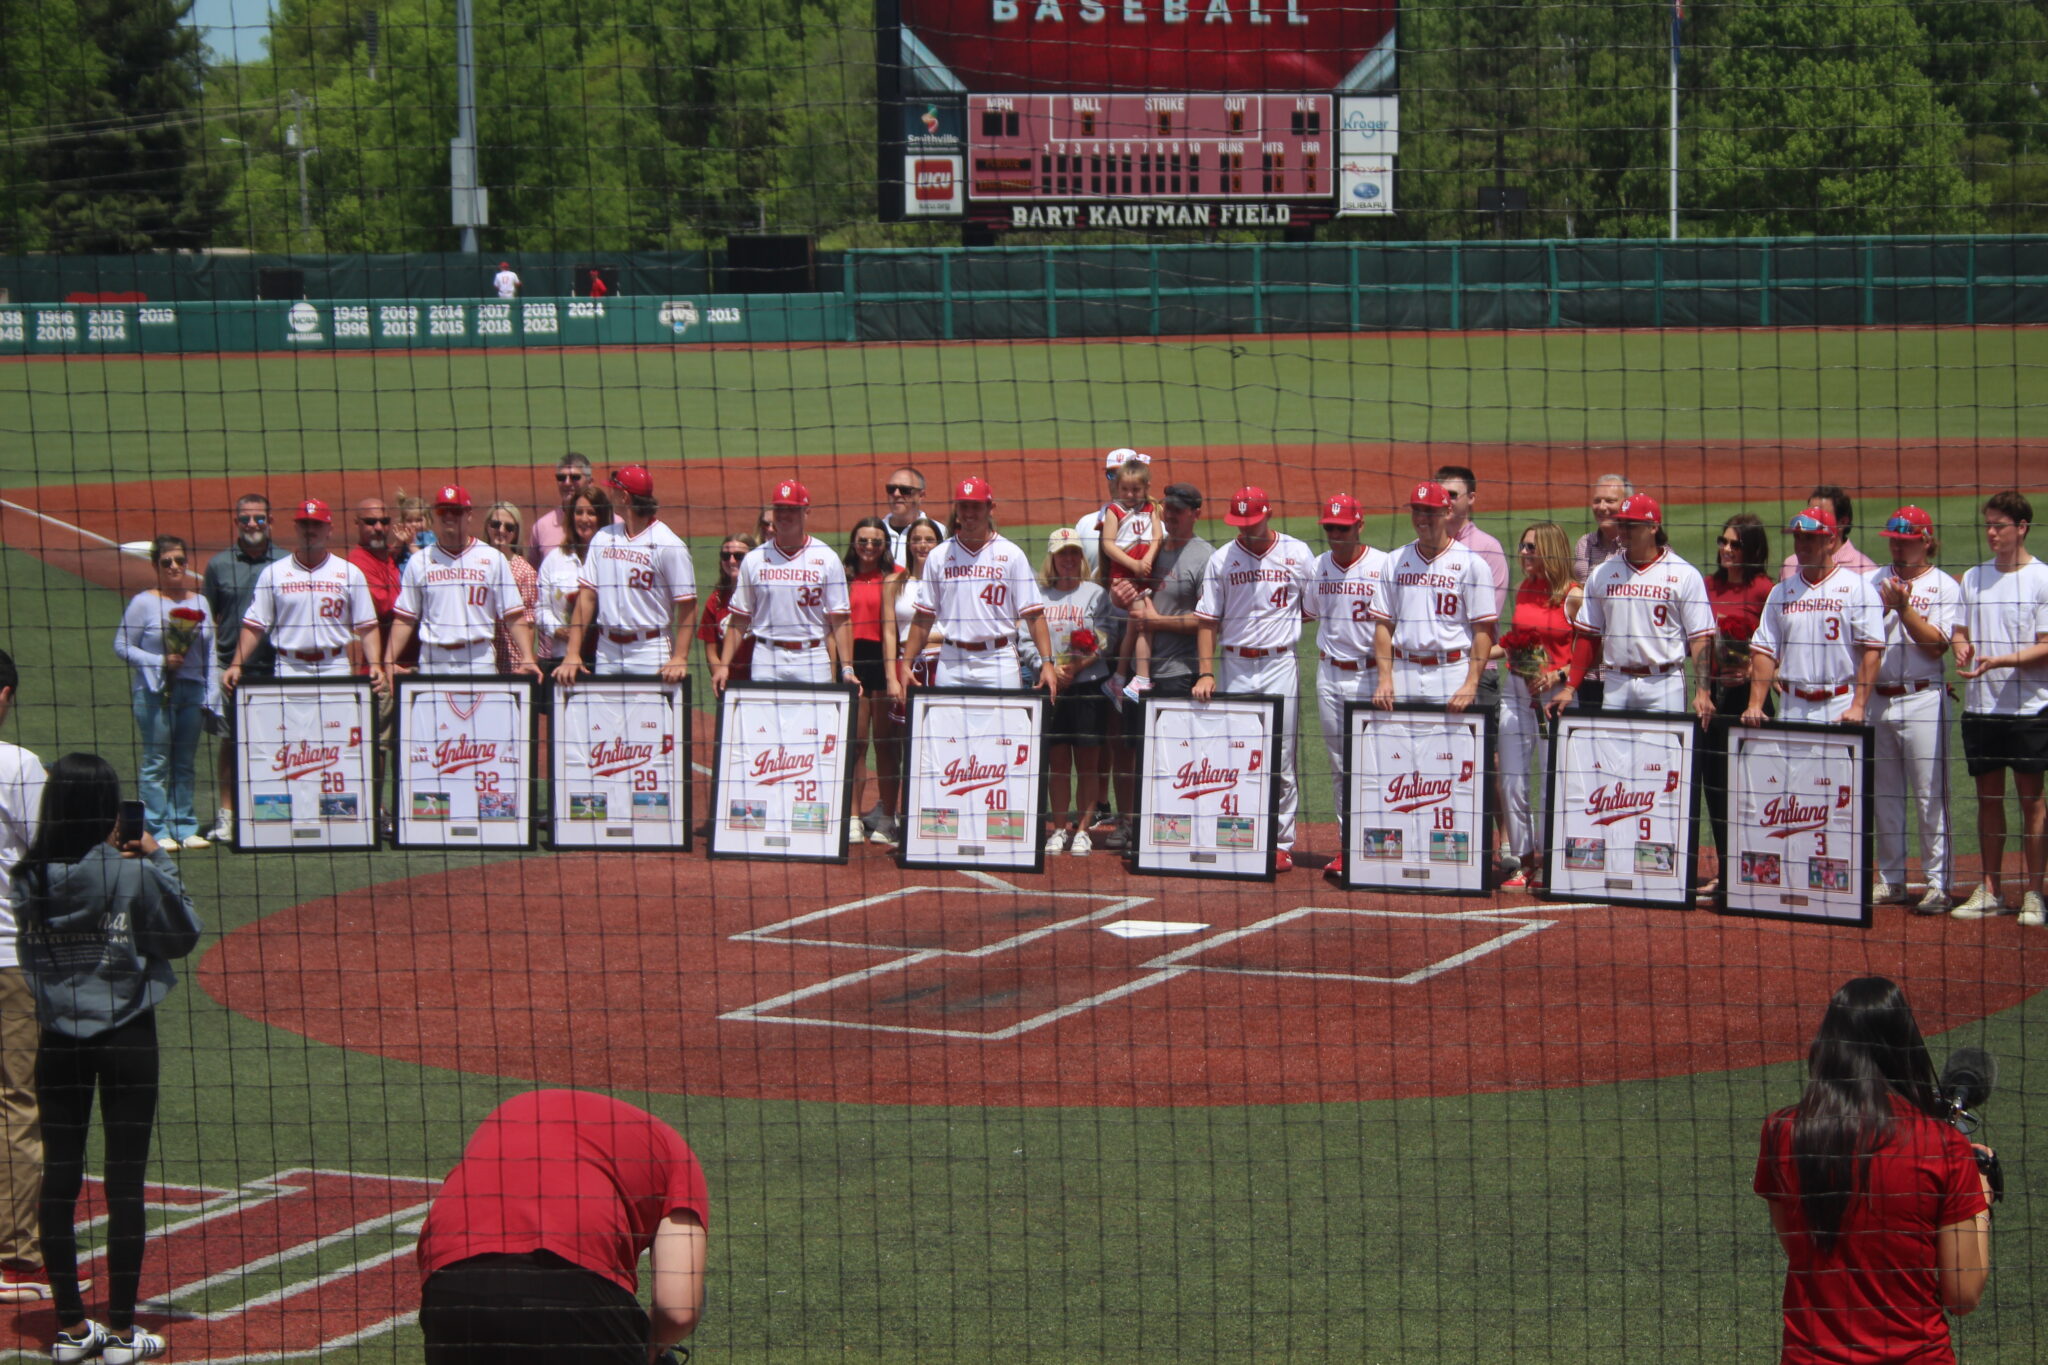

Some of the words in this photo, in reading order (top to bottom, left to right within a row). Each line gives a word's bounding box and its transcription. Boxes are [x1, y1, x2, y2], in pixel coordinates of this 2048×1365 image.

[993, 0, 1309, 24] BASEBALL
[986, 97, 1014, 111] MPH
[1073, 97, 1101, 111] BALL
[1145, 97, 1185, 111] STRIKE
[1224, 98, 1247, 111] OUT
[1344, 110, 1389, 139] Kroger
[907, 134, 959, 144] Smithville
[1218, 142, 1244, 153] RUNS
[1263, 141, 1284, 152] HITS
[1302, 141, 1320, 152] ERR
[1346, 201, 1388, 209] SUBARU
[1012, 205, 1079, 226] BART
[1088, 204, 1210, 225] KAUFMAN
[1220, 204, 1291, 225] FIELD
[88, 310, 125, 324] 2013
[139, 309, 174, 322] 2019
[334, 306, 368, 320] 1949
[380, 306, 418, 320] 2009
[429, 305, 464, 319] 2014
[478, 304, 510, 318] 2017
[523, 303, 557, 317] 2019
[568, 302, 604, 317] 2024
[707, 308, 740, 322] 2013
[36, 326, 77, 340] 2009
[88, 326, 126, 339] 2014
[334, 322, 369, 335] 1996
[382, 322, 417, 335] 2013
[430, 321, 464, 335] 2015
[478, 320, 512, 334] 2018
[523, 319, 557, 332] 2023
[602, 547, 651, 566] HOOSIERS
[427, 568, 486, 583] HOOSIERS
[629, 568, 655, 591] 29
[759, 568, 820, 583] HOOSIERS
[944, 565, 1003, 580] HOOSIERS
[1230, 569, 1291, 585] HOOSIERS
[1397, 572, 1455, 589] HOOSIERS
[281, 581, 343, 594] HOOSIERS
[468, 586, 488, 606] 10
[980, 583, 1006, 606] 40
[1319, 582, 1375, 596] HOOSIERS
[1606, 584, 1671, 600] HOOSIERS
[797, 586, 822, 607] 32
[1270, 586, 1288, 608] 41
[1435, 592, 1457, 615] 18
[320, 597, 344, 618] 28
[1352, 600, 1376, 622] 2
[1782, 598, 1843, 615] HOOSIERS
[1653, 604, 1667, 627] 9
[1824, 617, 1839, 640] 3
[272, 740, 340, 772] Indiana
[432, 734, 497, 768] Indiana
[587, 737, 653, 768] Indiana
[750, 746, 815, 777] Indiana
[940, 754, 1007, 786] Indiana
[321, 772, 344, 792] 28
[475, 771, 500, 792] 32
[634, 770, 657, 791] 29
[1172, 758, 1240, 790] Indiana
[794, 780, 817, 801] 32
[1384, 770, 1452, 803] Indiana
[984, 789, 1008, 810] 40
[1220, 793, 1239, 816] 41
[1585, 782, 1656, 815] Indiana
[1433, 807, 1454, 830] 18
[1760, 795, 1828, 827] Indiana
[1638, 817, 1651, 840] 9
[1814, 832, 1827, 856] 3
